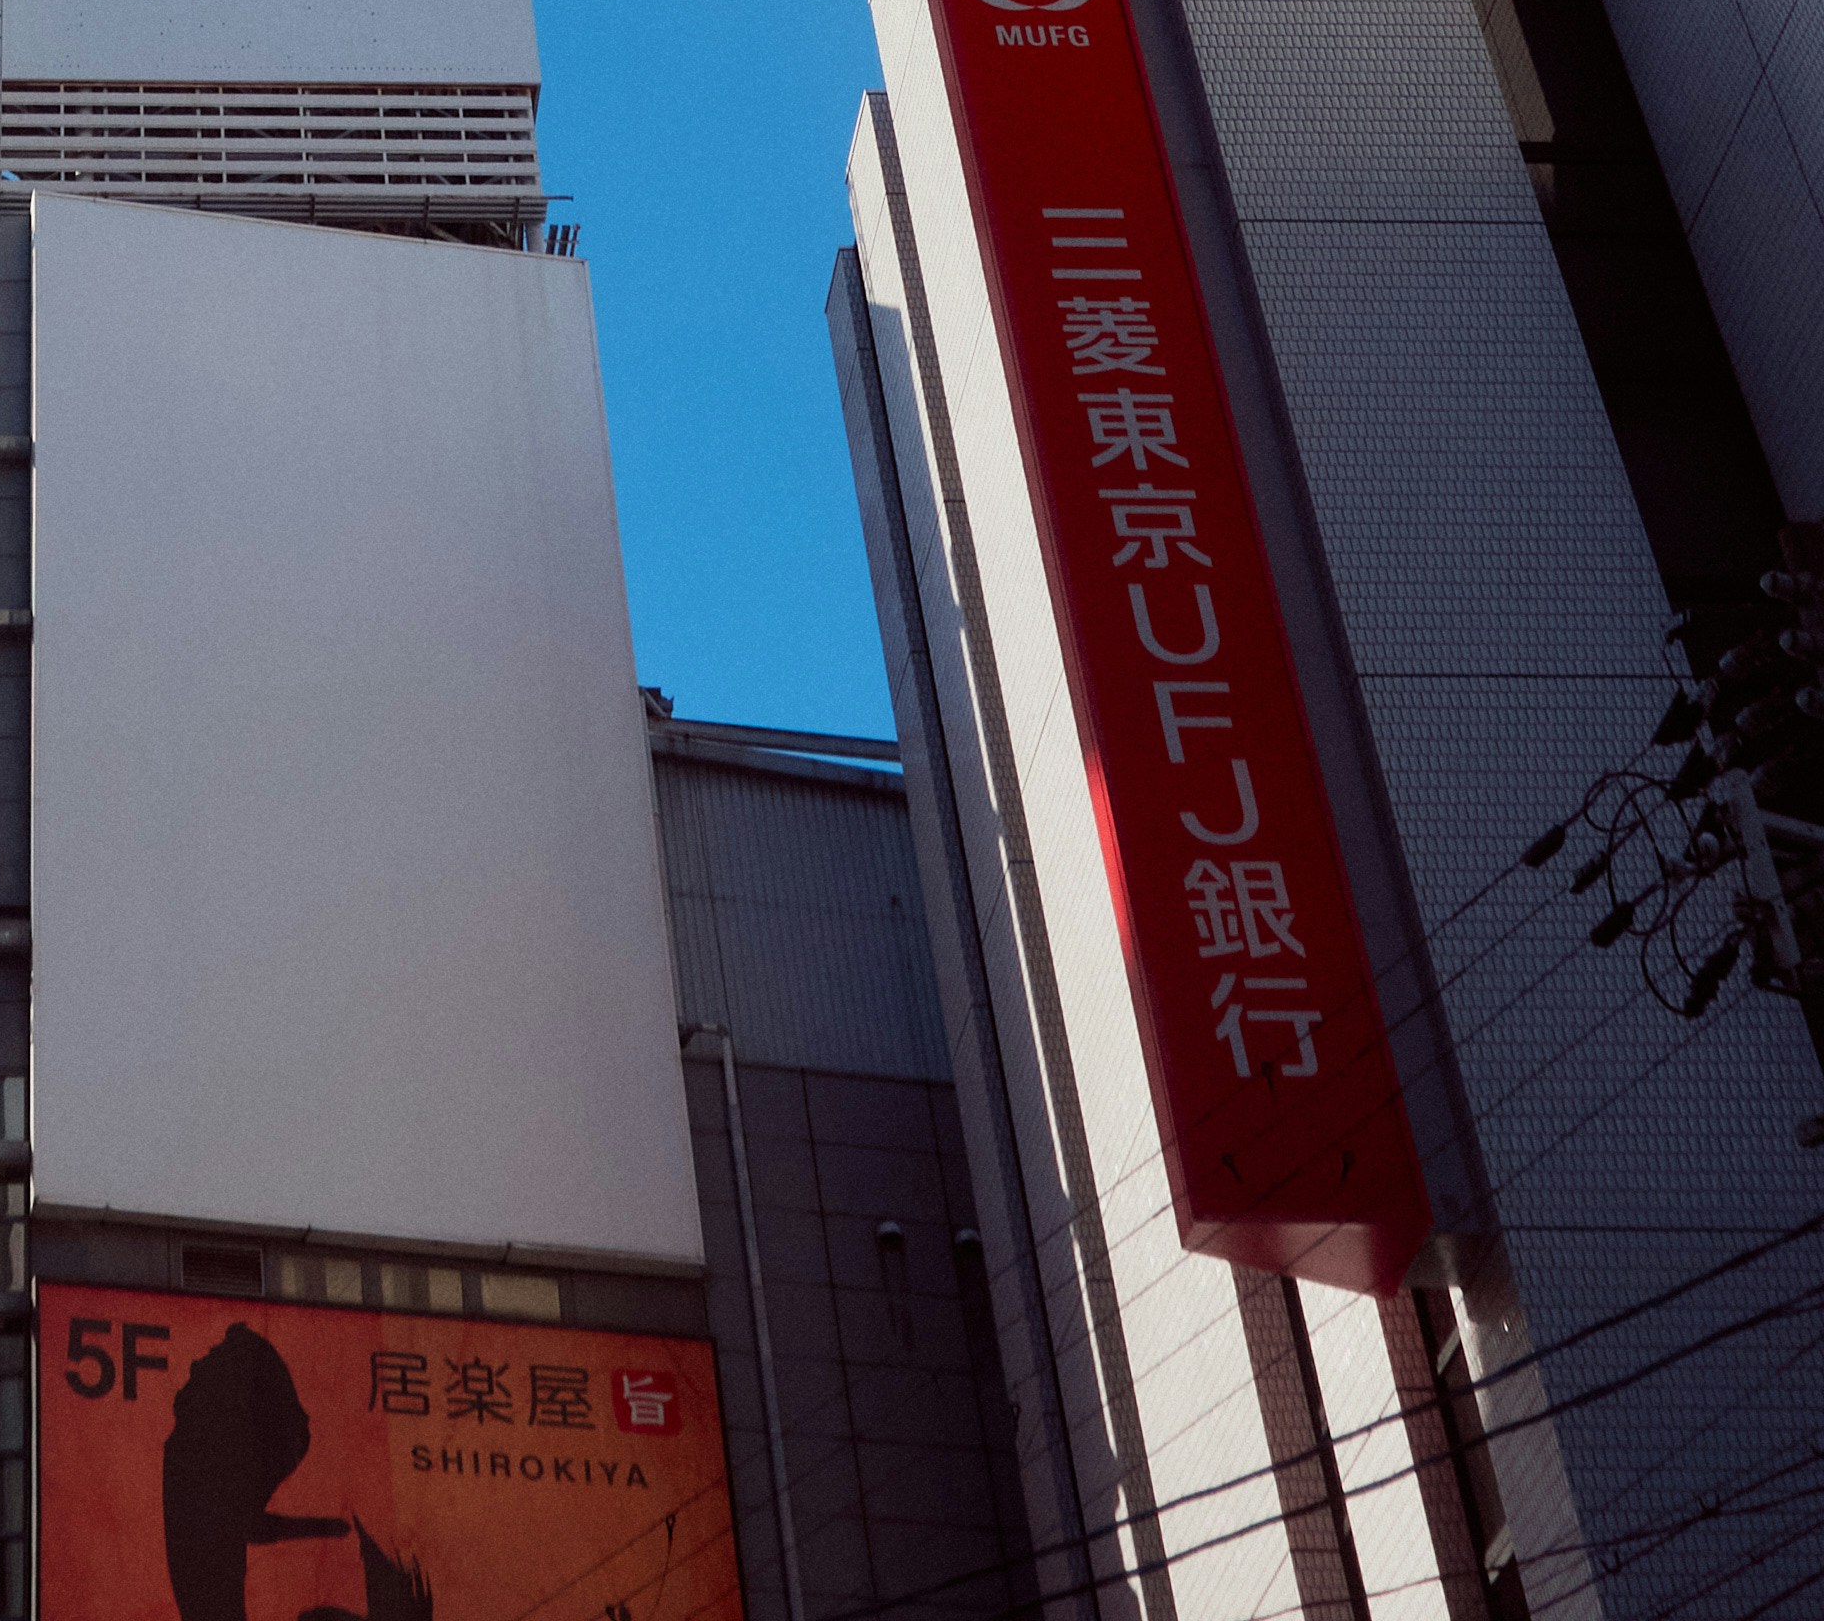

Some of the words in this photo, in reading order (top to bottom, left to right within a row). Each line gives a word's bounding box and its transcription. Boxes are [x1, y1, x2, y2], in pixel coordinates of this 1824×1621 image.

[995, 24, 1090, 47] MUFG
[1041, 207, 1323, 1079] 三菱東京UFJ銀行
[64, 1316, 171, 1402] 5F
[367, 1350, 597, 1431] 居楽屋
[410, 1444, 650, 1489] SHIROKIYA
